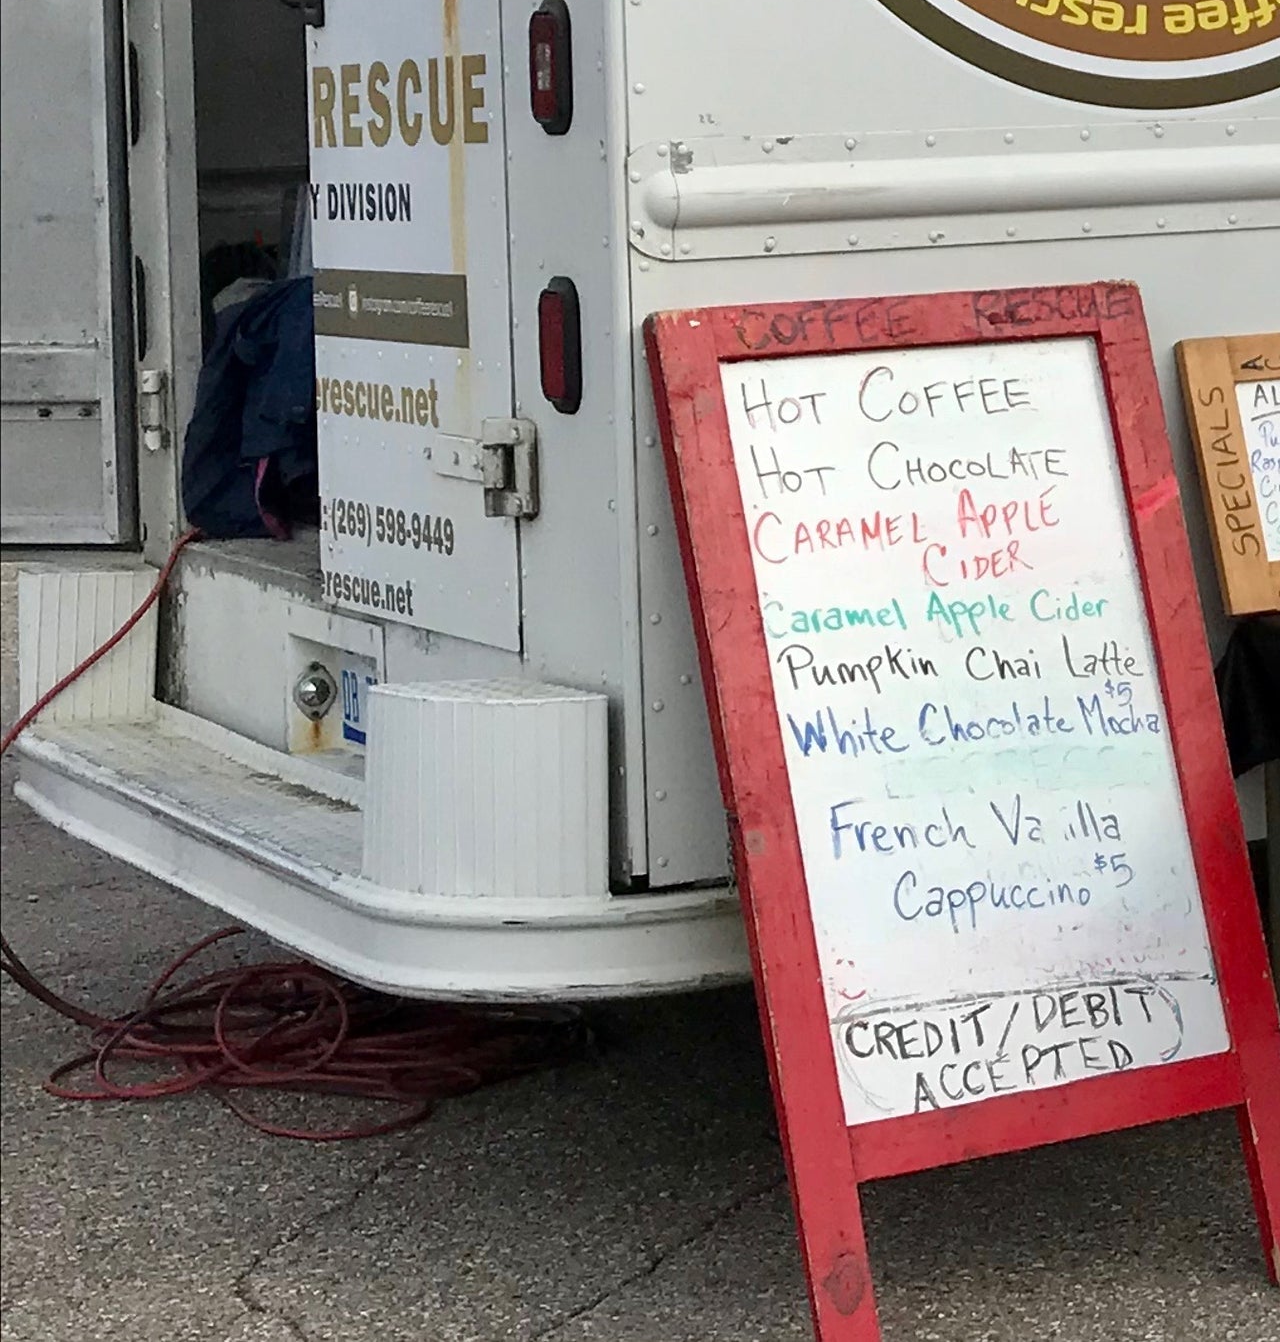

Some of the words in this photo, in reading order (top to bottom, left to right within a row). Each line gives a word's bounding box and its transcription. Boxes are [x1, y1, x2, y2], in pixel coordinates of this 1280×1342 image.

[312, 53, 490, 149] RESCUE
[327, 182, 412, 222] DIVISION
[733, 296, 924, 351] COFFEE
[971, 287, 1135, 326] RESCUE
[740, 377, 828, 430] HOT
[858, 365, 1033, 423] COFFEE
[749, 443, 836, 500] HOT
[867, 441, 1070, 492] CHOCOLATE
[1199, 385, 1261, 557] SPECIALS
[331, 497, 373, 548] (269)
[376, 505, 455, 557] 598-9449
[753, 510, 928, 566] CARAMEL
[956, 484, 1060, 540] APPLE
[922, 537, 1034, 589] CIDER
[763, 593, 907, 642] Caramel
[926, 589, 1016, 640] Apple
[1029, 590, 1110, 622] Cider
[776, 642, 940, 695] Pumpkin
[965, 645, 1042, 682] Chai
[1061, 634, 1145, 678] Latte
[1103, 678, 1134, 707] $5
[786, 704, 910, 758] White
[917, 694, 1075, 747] Chocolate
[1078, 694, 1163, 737] Mocha
[829, 798, 977, 859] French
[990, 793, 1121, 848] Vailla
[893, 870, 1092, 934] Cappuccino
[1093, 852, 1137, 888] $5
[912, 1036, 1135, 1114] ACCEPTED
